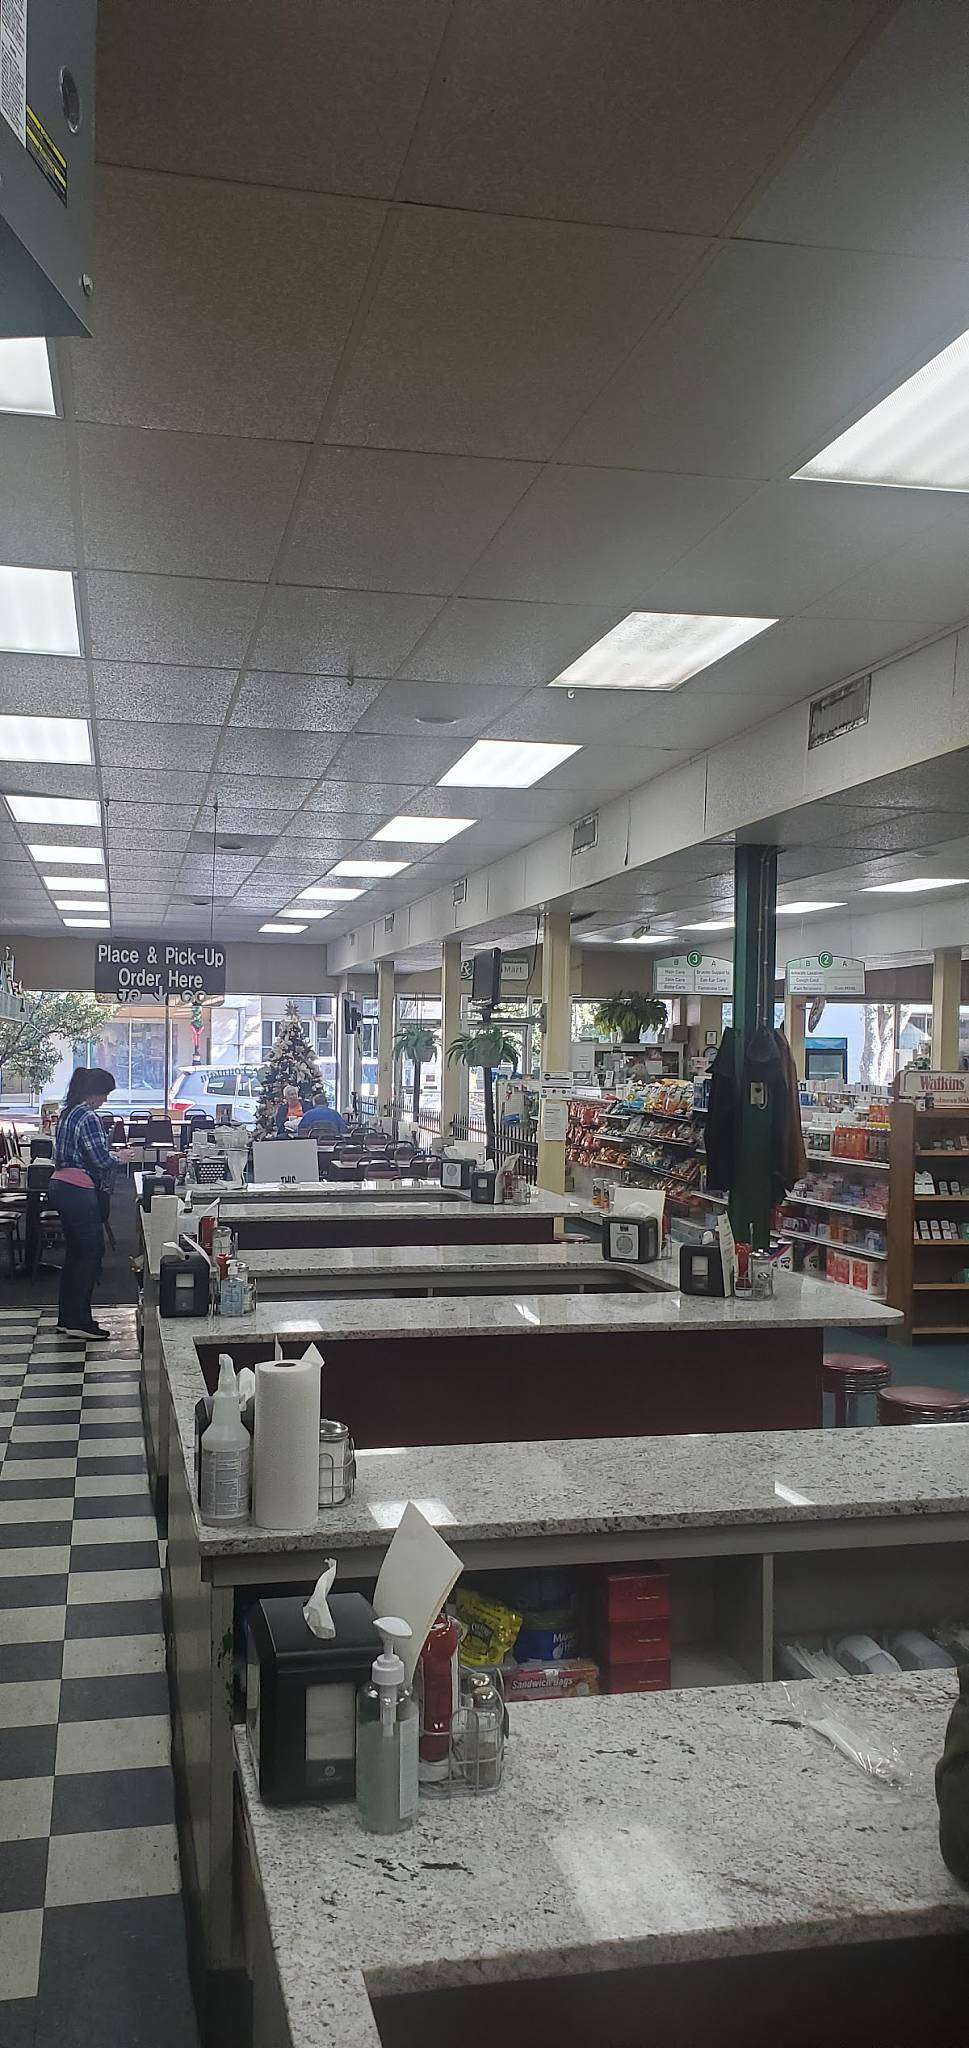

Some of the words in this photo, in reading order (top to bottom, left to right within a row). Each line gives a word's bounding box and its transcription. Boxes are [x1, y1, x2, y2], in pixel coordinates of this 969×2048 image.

[98, 944, 139, 964] Place
[147, 946, 158, 964] &
[165, 946, 224, 968] Pick-Up
[692, 954, 698, 963] 3
[823, 955, 829, 964] 2
[504, 965, 522, 974] Mart
[118, 967, 161, 987] Order
[168, 969, 203, 989] Here
[118, 988, 142, 1002] TO
[181, 989, 207, 1004] GO
[919, 1075, 965, 1090] Watkins
[511, 1678, 552, 1690] Sandwich
